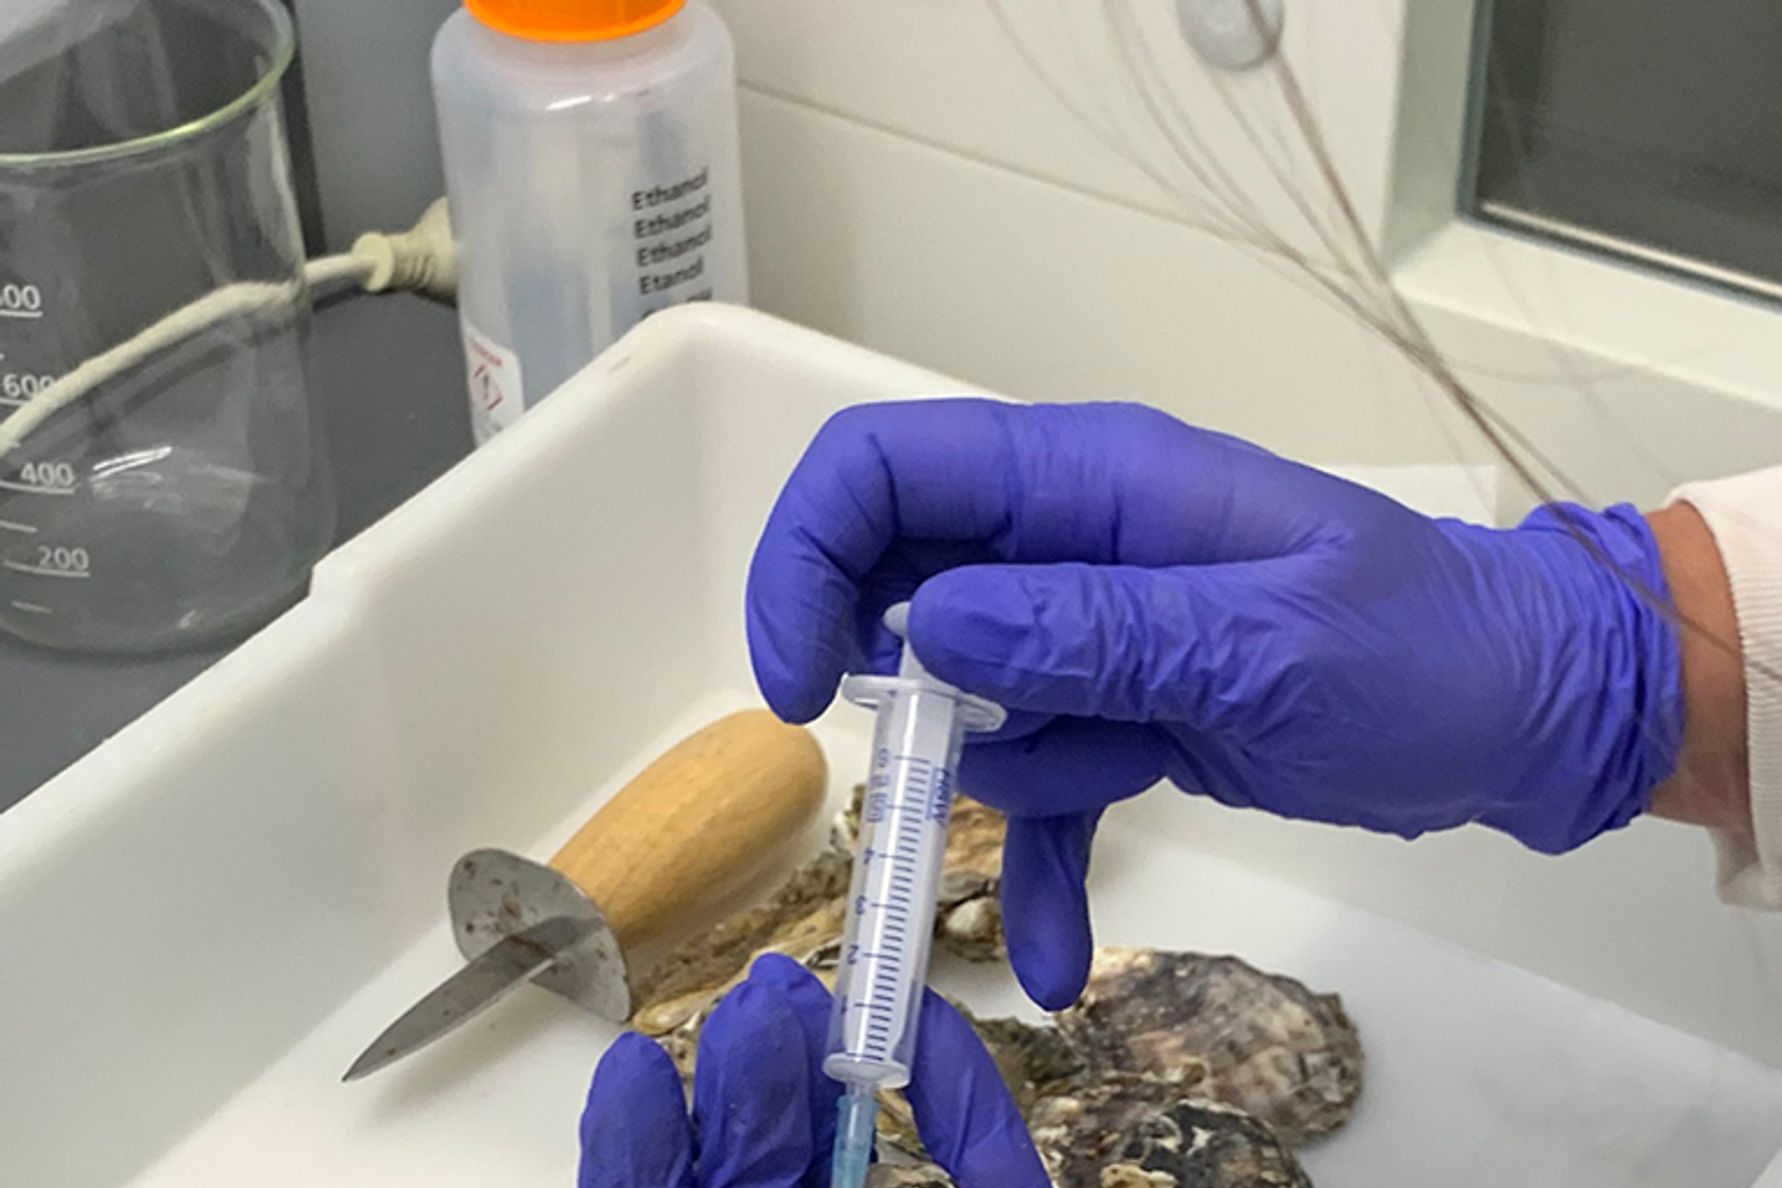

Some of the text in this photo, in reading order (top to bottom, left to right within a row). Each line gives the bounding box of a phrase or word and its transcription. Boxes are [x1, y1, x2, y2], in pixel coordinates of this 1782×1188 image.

[632, 167, 709, 211] Ethanol
[635, 194, 711, 239] Ethanol
[637, 223, 713, 268] Ethanol
[640, 256, 704, 295] Etanol
[0, 283, 42, 311] 00
[20, 461, 76, 487] 400
[37, 545, 90, 571] 200
